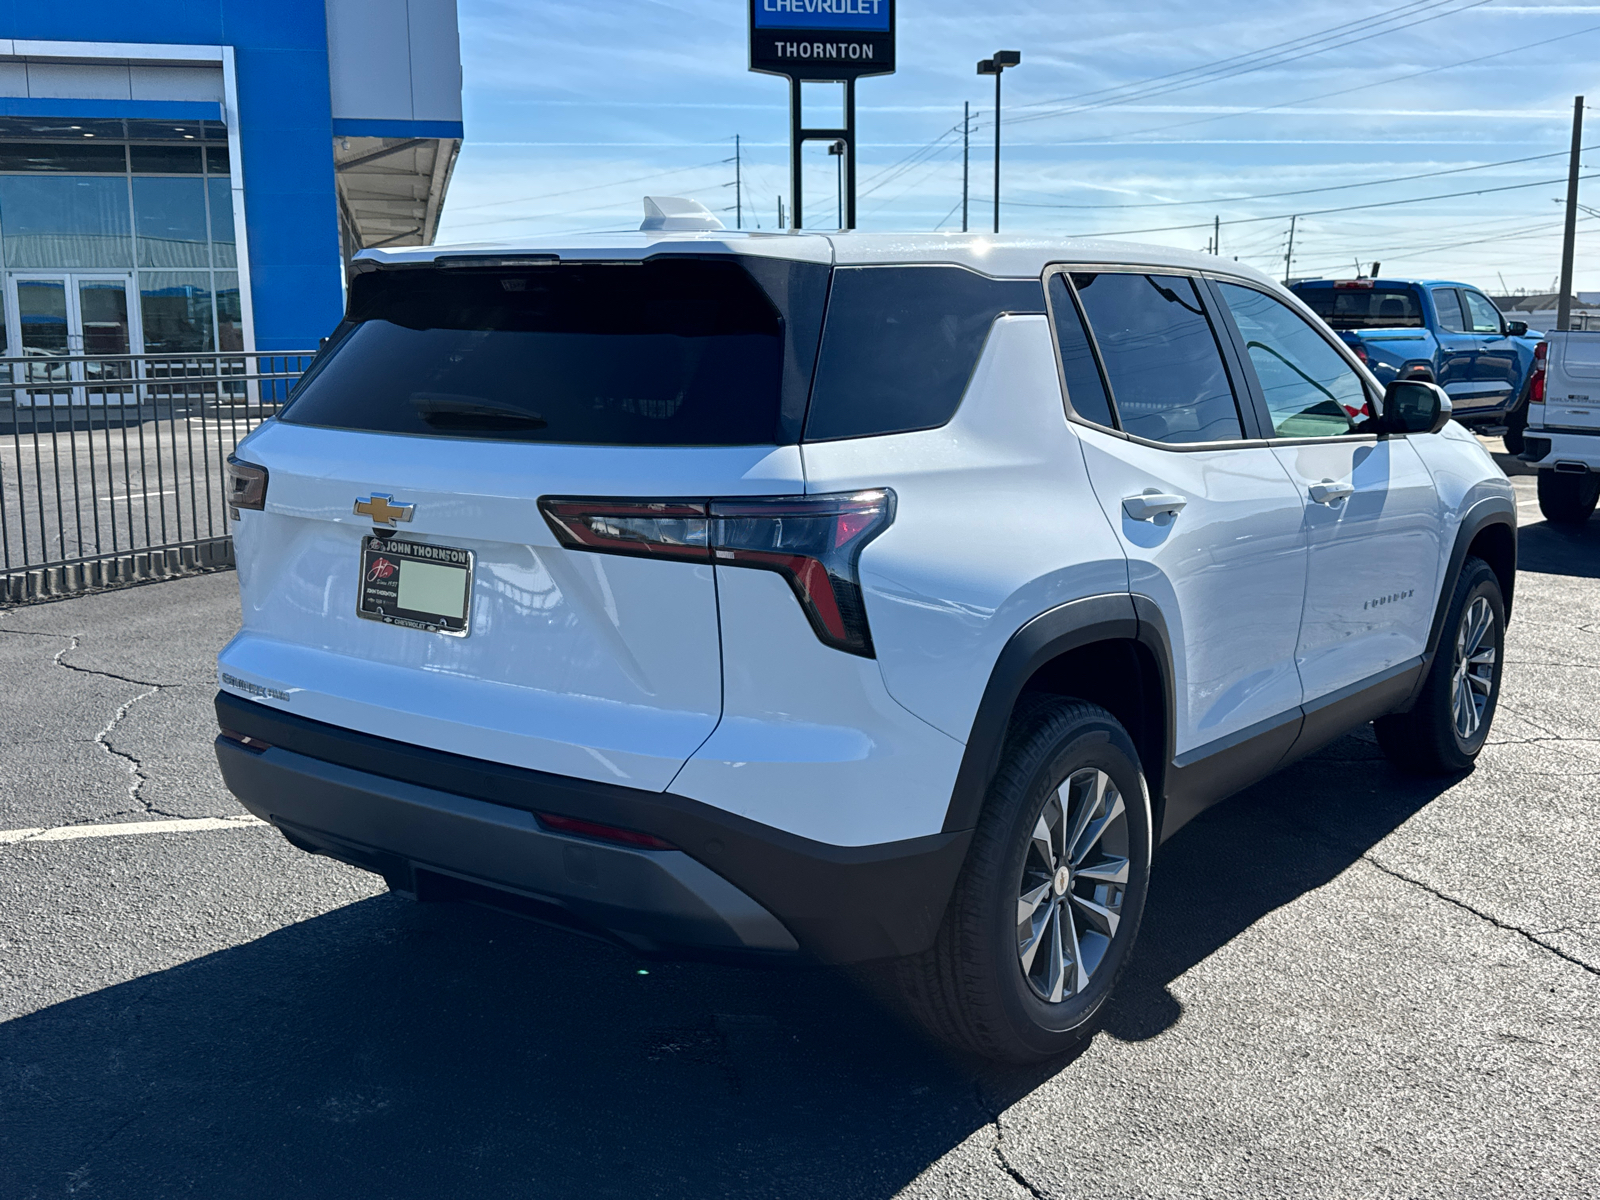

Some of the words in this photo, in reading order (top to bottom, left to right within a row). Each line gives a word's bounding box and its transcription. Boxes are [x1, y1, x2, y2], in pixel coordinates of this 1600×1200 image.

[763, 0, 882, 14] CHEVROLET
[774, 41, 874, 59] THORNTON
[386, 541, 411, 555] JOHN
[413, 545, 466, 563] THORNTON
[394, 618, 426, 630] CHEVROLET
